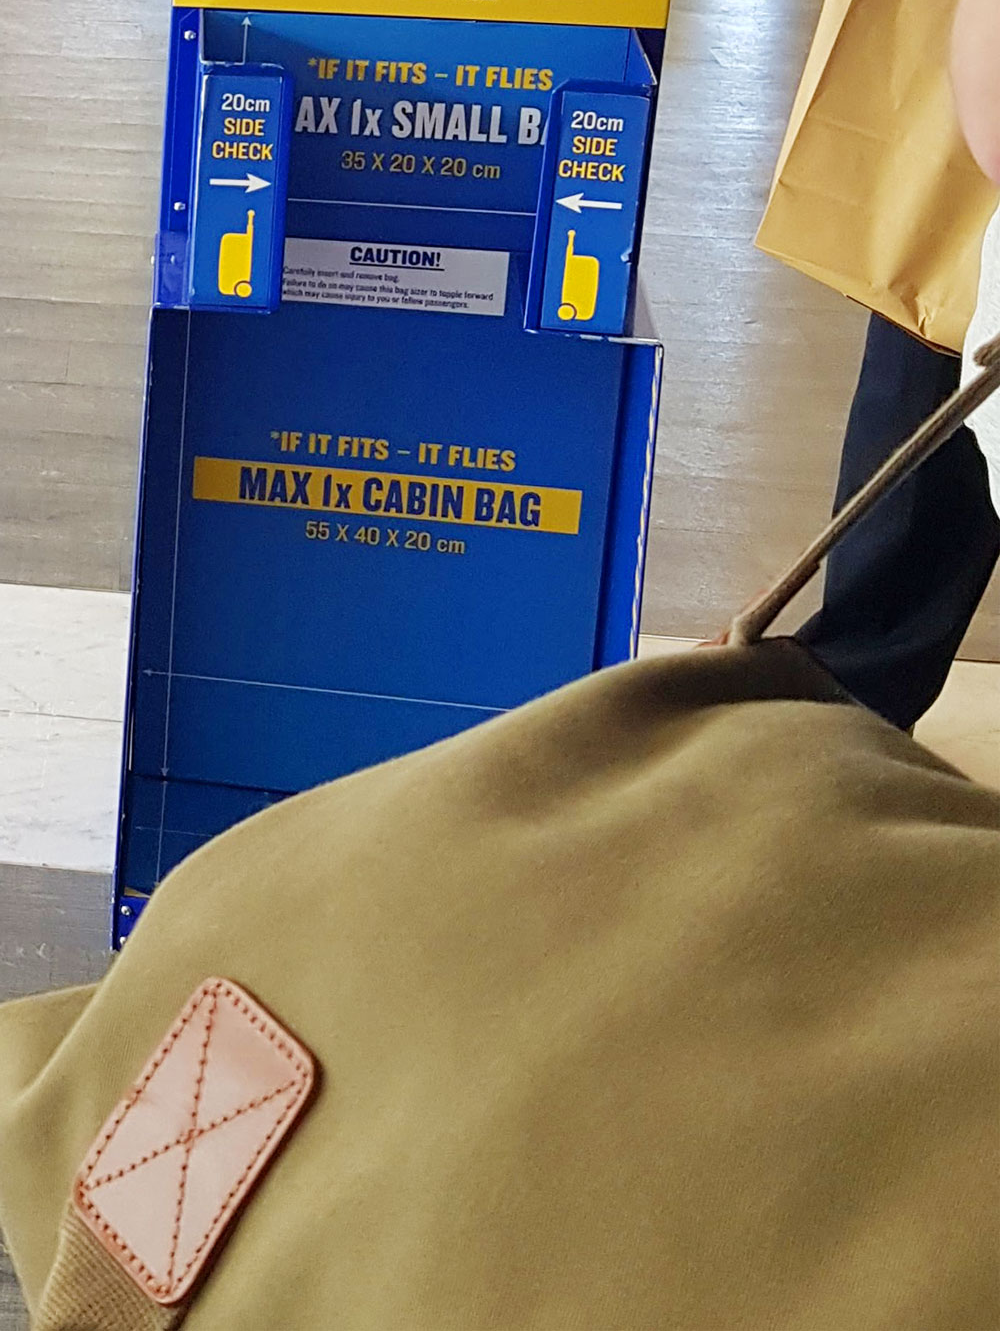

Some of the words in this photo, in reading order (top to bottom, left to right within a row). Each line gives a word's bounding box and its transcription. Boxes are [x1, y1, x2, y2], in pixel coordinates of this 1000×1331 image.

[346, 59, 370, 81] IT
[374, 61, 427, 85] FITS
[455, 65, 480, 86] IT
[485, 66, 554, 91] FLIES
[221, 93, 271, 112] 20cm
[223, 117, 266, 137] SIDE
[294, 95, 342, 134] AX
[391, 100, 507, 144] SMALL
[570, 110, 624, 132] 20cm
[211, 140, 274, 160] CHECK
[572, 135, 618, 157] SIDE
[341, 150, 366, 170] 35
[371, 153, 385, 171] X
[389, 154, 416, 174] 20
[420, 156, 436, 175] X
[440, 156, 467, 177] 20
[472, 163, 501, 179] cm
[558, 159, 626, 182] CHECK
[350, 246, 442, 267] CAUTION!
[304, 290, 320, 299] may
[367, 293, 376, 302] to
[376, 295, 391, 304] you
[308, 280, 316, 288] to
[395, 286, 409, 296] bag
[430, 288, 438, 297] to
[464, 290, 494, 301] forward
[308, 433, 333, 455] IT
[337, 435, 390, 460] FITS
[418, 442, 444, 466] IT
[448, 444, 517, 472] FLIES
[238, 465, 314, 506] MAX
[362, 477, 464, 520] CABIN
[474, 487, 542, 528] BAG
[304, 520, 330, 541] 55
[335, 523, 350, 542] X
[354, 526, 381, 546] 40
[386, 529, 399, 547] X
[404, 530, 432, 551] 20
[436, 537, 466, 555] cm
